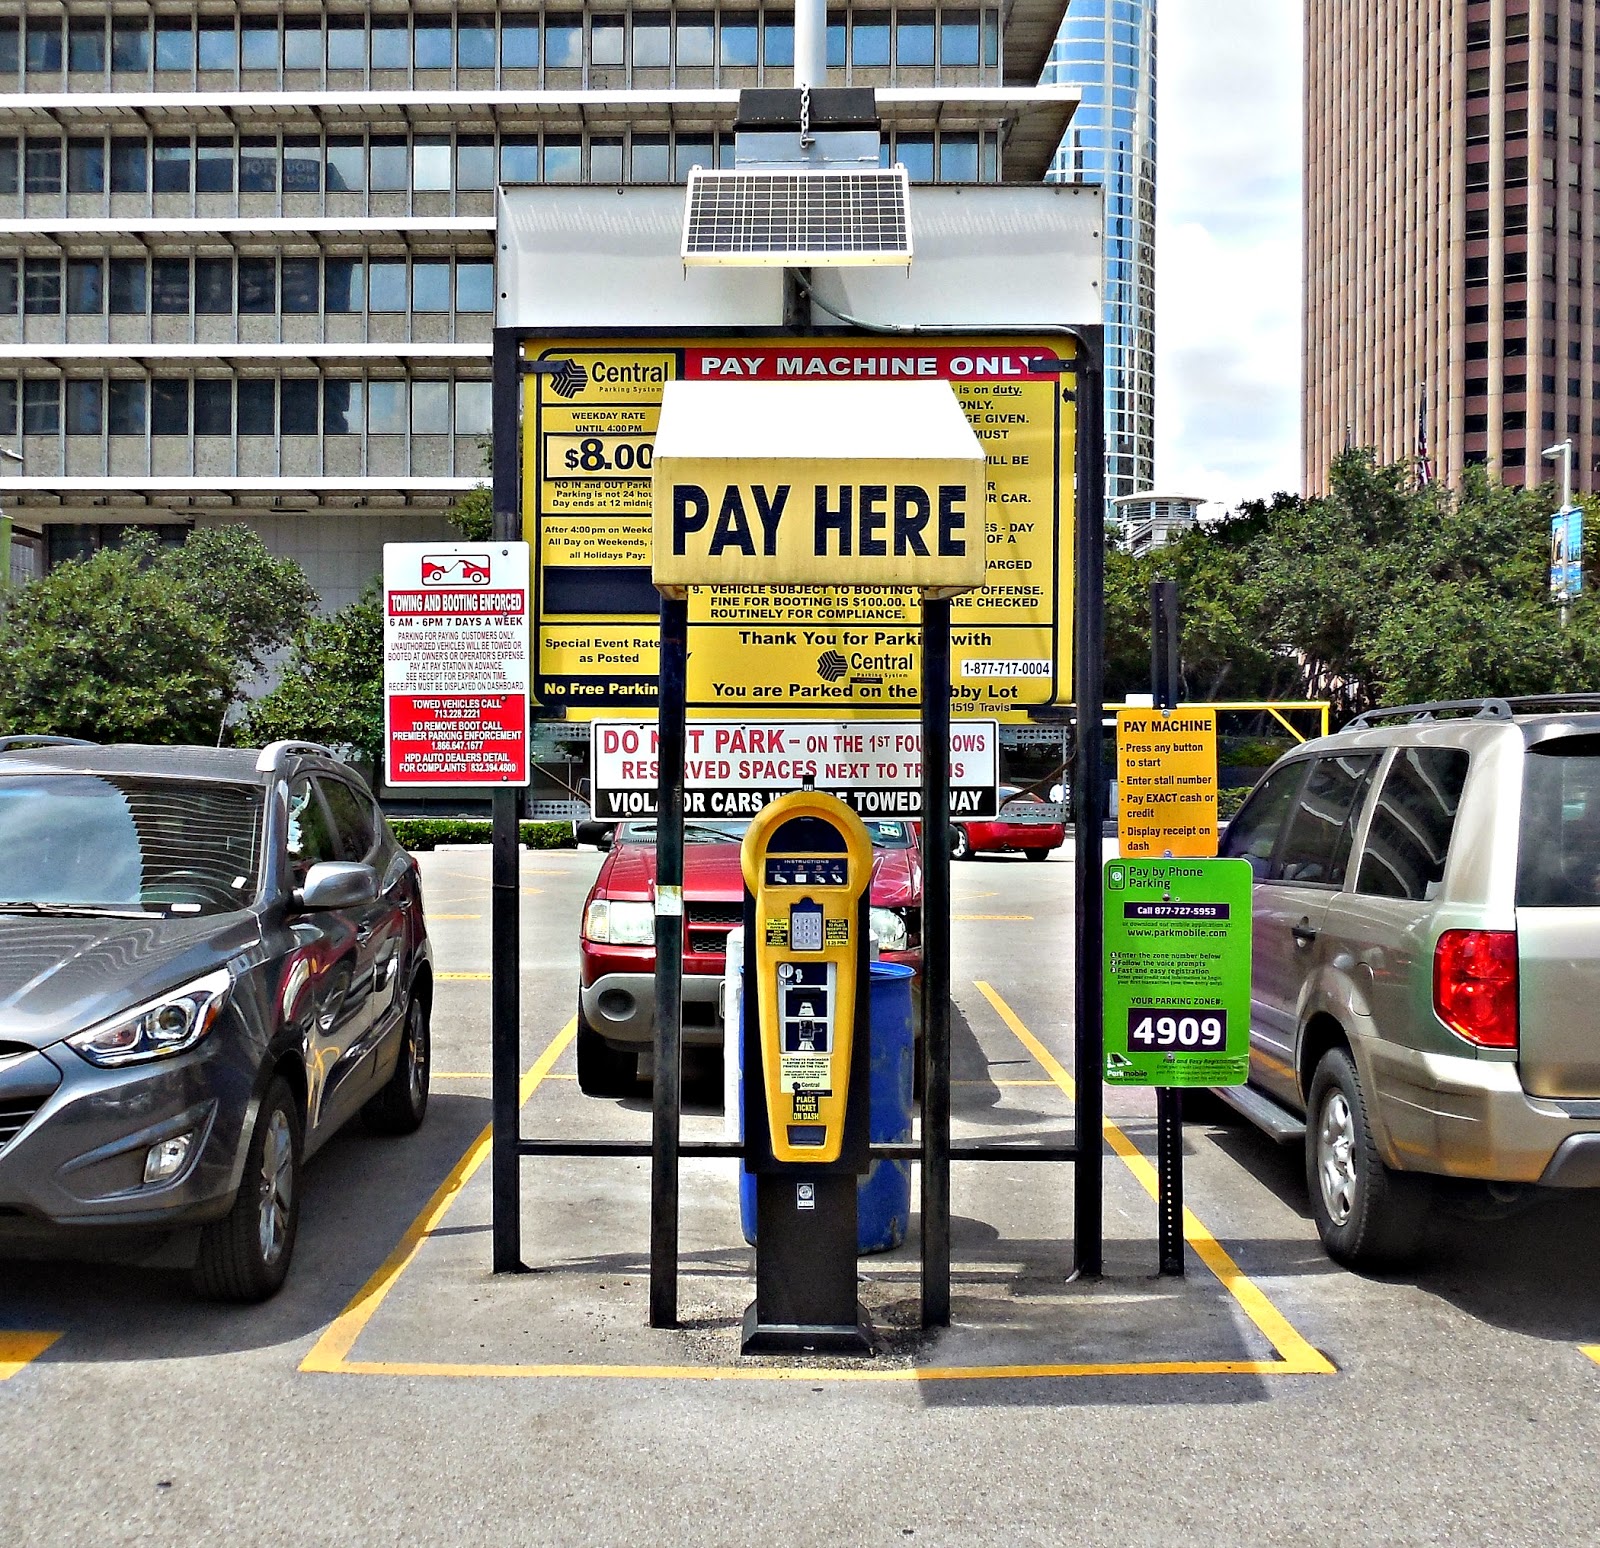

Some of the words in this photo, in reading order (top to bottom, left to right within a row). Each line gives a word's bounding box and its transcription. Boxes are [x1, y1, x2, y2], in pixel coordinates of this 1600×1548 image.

[701, 357, 765, 375] PAY
[777, 357, 938, 375] MACHINE
[592, 361, 669, 383] Central
[993, 385, 1022, 396] duty.
[959, 401, 994, 409] ONLY.
[572, 412, 618, 420] WEEKDAY
[621, 412, 646, 420] RATE
[985, 415, 1029, 423] GIVEN.
[565, 438, 654, 471] $8.00
[1012, 456, 1029, 465] BE
[1001, 494, 1031, 503] CAR.
[552, 500, 568, 508] Day
[673, 485, 791, 556] PAY
[813, 485, 967, 556] HERE
[1009, 524, 1034, 532] DAY
[564, 538, 580, 547] Day
[598, 538, 647, 546] Weekends,
[584, 552, 623, 560] Holidays
[626, 552, 646, 560] Pay:
[711, 586, 765, 594] VEHICLE
[770, 586, 828, 594] SUBJECT
[834, 586, 850, 594] TO
[854, 586, 912, 594] BOOTING
[981, 586, 1044, 595] OFFENSE.
[391, 594, 422, 612] TOWING
[424, 594, 441, 612] AND
[443, 594, 478, 612] BOOTING
[479, 593, 522, 611] ENFORCED
[710, 598, 740, 606] FINE
[744, 598, 769, 606] FOR
[773, 598, 832, 606] BOOTING
[836, 598, 848, 606] IS
[853, 597, 905, 607] $100.00.
[977, 598, 1038, 607] CHECKED
[710, 609, 783, 618] ROUTINELY
[788, 609, 813, 618] FOR
[817, 609, 905, 618] COMPLIANCE.
[446, 618, 452, 626] 7
[455, 618, 481, 626] DAYS
[485, 618, 491, 626] A
[495, 617, 523, 626] WEEK
[398, 632, 423, 640] PARKING
[425, 632, 437, 640] FOR
[438, 632, 459, 640] PAYING
[462, 632, 497, 640] CUSTOMERS
[739, 631, 797, 645] Thank
[802, 631, 837, 645] You
[843, 631, 868, 645] for
[951, 632, 992, 645] with
[545, 639, 590, 649] Special
[594, 639, 629, 648] Event
[579, 655, 593, 663] as
[598, 654, 640, 663] Posted
[851, 653, 913, 670] Central
[964, 662, 1049, 675] 1-877-717-0004
[544, 683, 566, 695] No
[570, 683, 605, 695] Free
[712, 683, 746, 697] You
[752, 686, 783, 697] are
[789, 683, 853, 697] Parked
[860, 686, 881, 697] on
[888, 684, 918, 697] the
[989, 685, 1018, 697] Lot
[412, 699, 440, 708] TOWED
[442, 699, 479, 708] VEHICLES
[481, 699, 502, 708] CALL
[951, 703, 974, 712] 1519
[979, 703, 1010, 712] Travis
[412, 722, 423, 730] TO
[424, 722, 457, 730] REMOVE
[459, 722, 480, 730] BOOT
[482, 722, 502, 730] CALL
[1124, 721, 1147, 732] PAY
[1151, 720, 1211, 732] MACHINE
[393, 731, 427, 740] PREMIER
[428, 731, 462, 740] PARKING
[464, 731, 522, 740] ENFORCEMENT
[603, 729, 639, 754] DO
[806, 735, 828, 753] ON
[834, 735, 863, 753] THE
[869, 735, 890, 753] 1ST
[1126, 744, 1151, 752] Press
[1154, 745, 1171, 754] any
[1173, 743, 1203, 752] button
[405, 754, 421, 762] HPD
[423, 754, 444, 762] AUTO
[445, 754, 481, 762] DEALERS
[483, 753, 510, 762] DETAIL
[1126, 759, 1136, 767] to
[1138, 759, 1161, 767] start
[399, 764, 415, 772] FOR
[417, 764, 466, 772] COMPLAINTS
[739, 761, 817, 779] SPACES
[826, 763, 870, 778] NEXT
[876, 763, 898, 778] TO
[1127, 776, 1151, 785] Enter
[1154, 776, 1174, 785] stall
[1177, 776, 1211, 784] number
[711, 792, 763, 812] CARS
[854, 792, 921, 811] TOWED
[1127, 794, 1144, 805] Pay
[1146, 794, 1178, 803] EXACT
[1180, 793, 1202, 802] cash
[1127, 808, 1154, 818] credit
[1127, 827, 1161, 837] Display
[1163, 826, 1196, 837] receipt
[1127, 842, 1149, 850] dash
[1129, 867, 1149, 878] Pay
[1152, 867, 1165, 878] by
[1169, 867, 1203, 877] Phone
[1129, 879, 1171, 890] Parking
[1137, 906, 1152, 915] Call
[1155, 906, 1216, 915] 877-727-5953
[1128, 929, 1227, 938] www.parkmobile.com
[1134, 1017, 1221, 1045] 4909
[795, 1104, 817, 1112] TICKET
